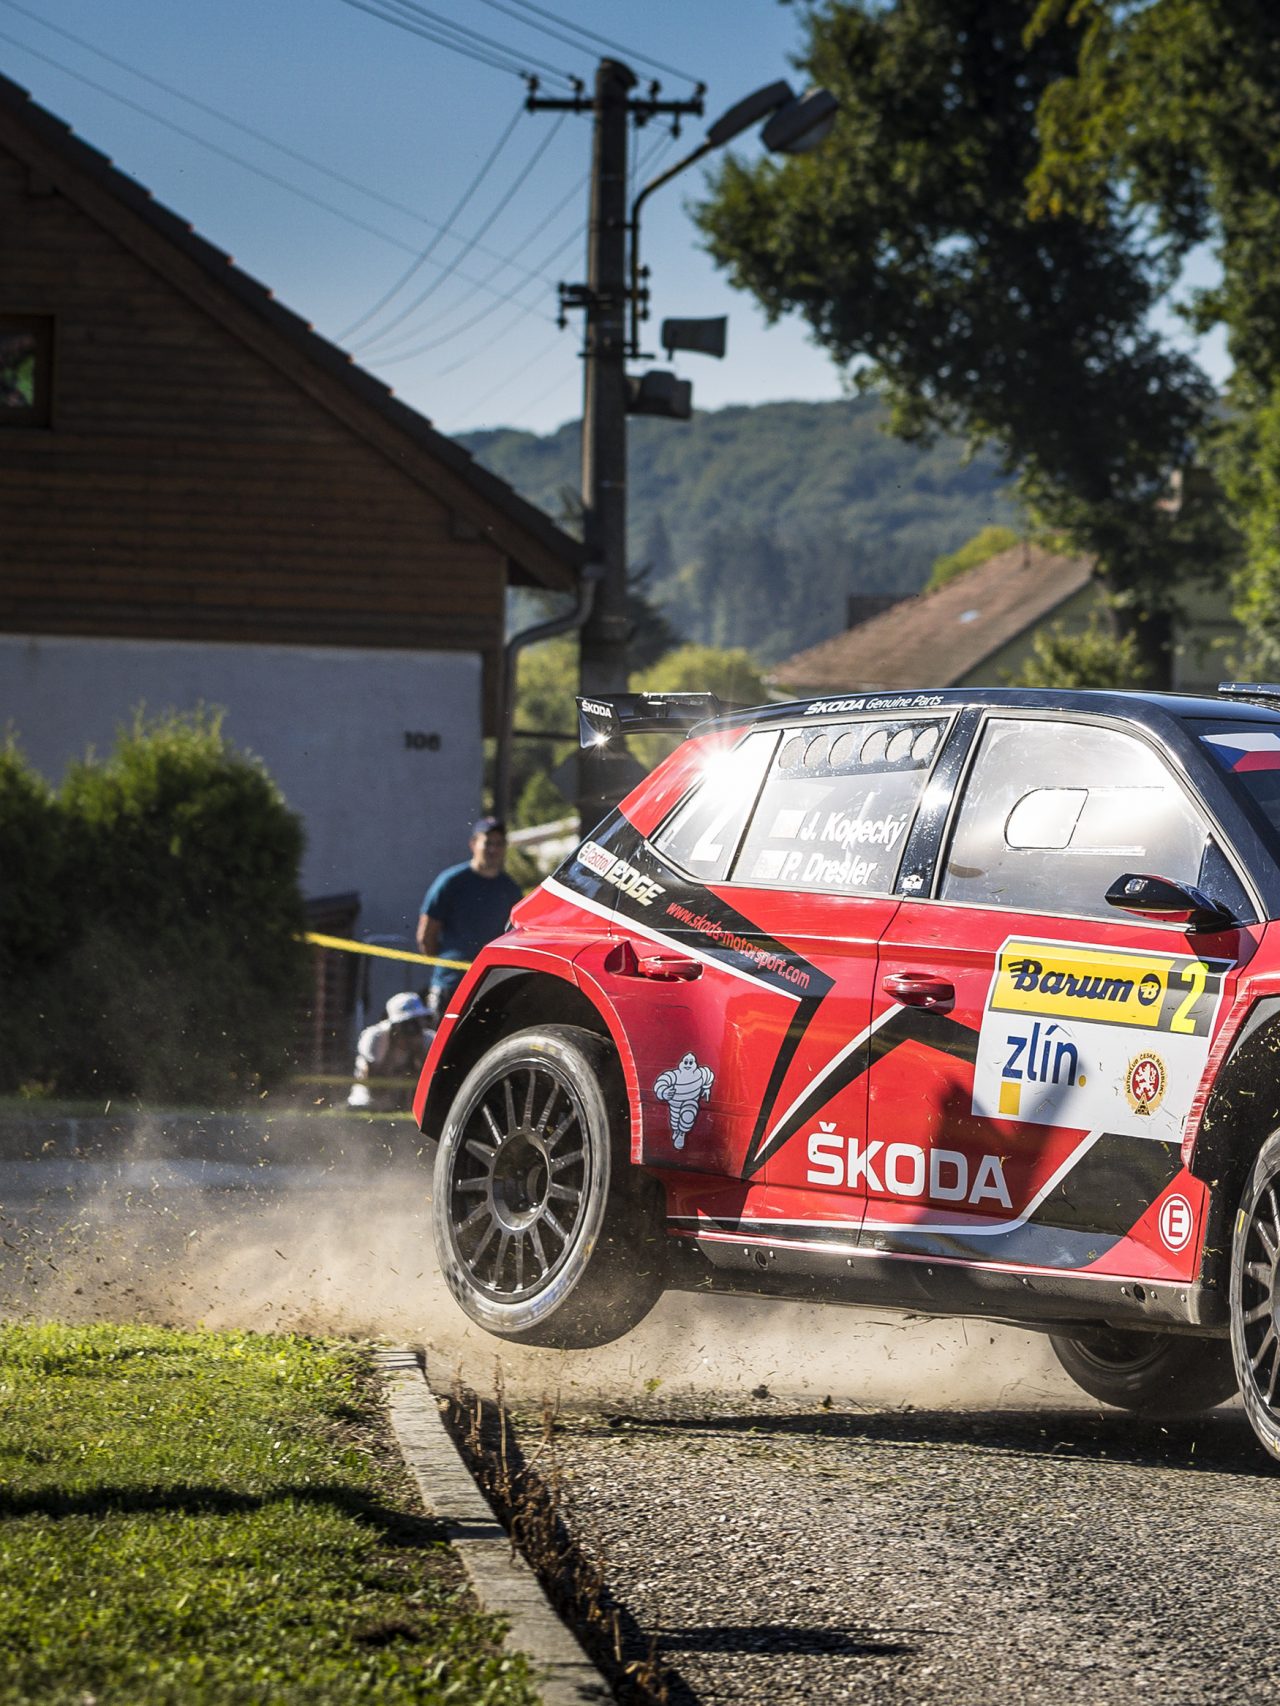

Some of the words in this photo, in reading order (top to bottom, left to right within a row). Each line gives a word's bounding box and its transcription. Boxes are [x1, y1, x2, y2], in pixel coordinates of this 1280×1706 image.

[582, 700, 612, 718] ŠKODA
[804, 699, 866, 715] ŠKODA
[866, 696, 912, 709] Genuine
[911, 695, 944, 707] Parts
[800, 811, 819, 841] J.
[821, 812, 907, 851] Kopecký
[585, 845, 615, 873] Castrol
[605, 858, 666, 906] EDGE
[782, 851, 800, 881] P.
[802, 852, 878, 885] Dresler
[665, 903, 810, 989] www.skoda-motorsport.com
[1008, 959, 1134, 1002] Barum
[1169, 961, 1209, 1034] 2
[806, 1121, 1013, 1208] ŠKODA
[1169, 1205, 1183, 1237] E
